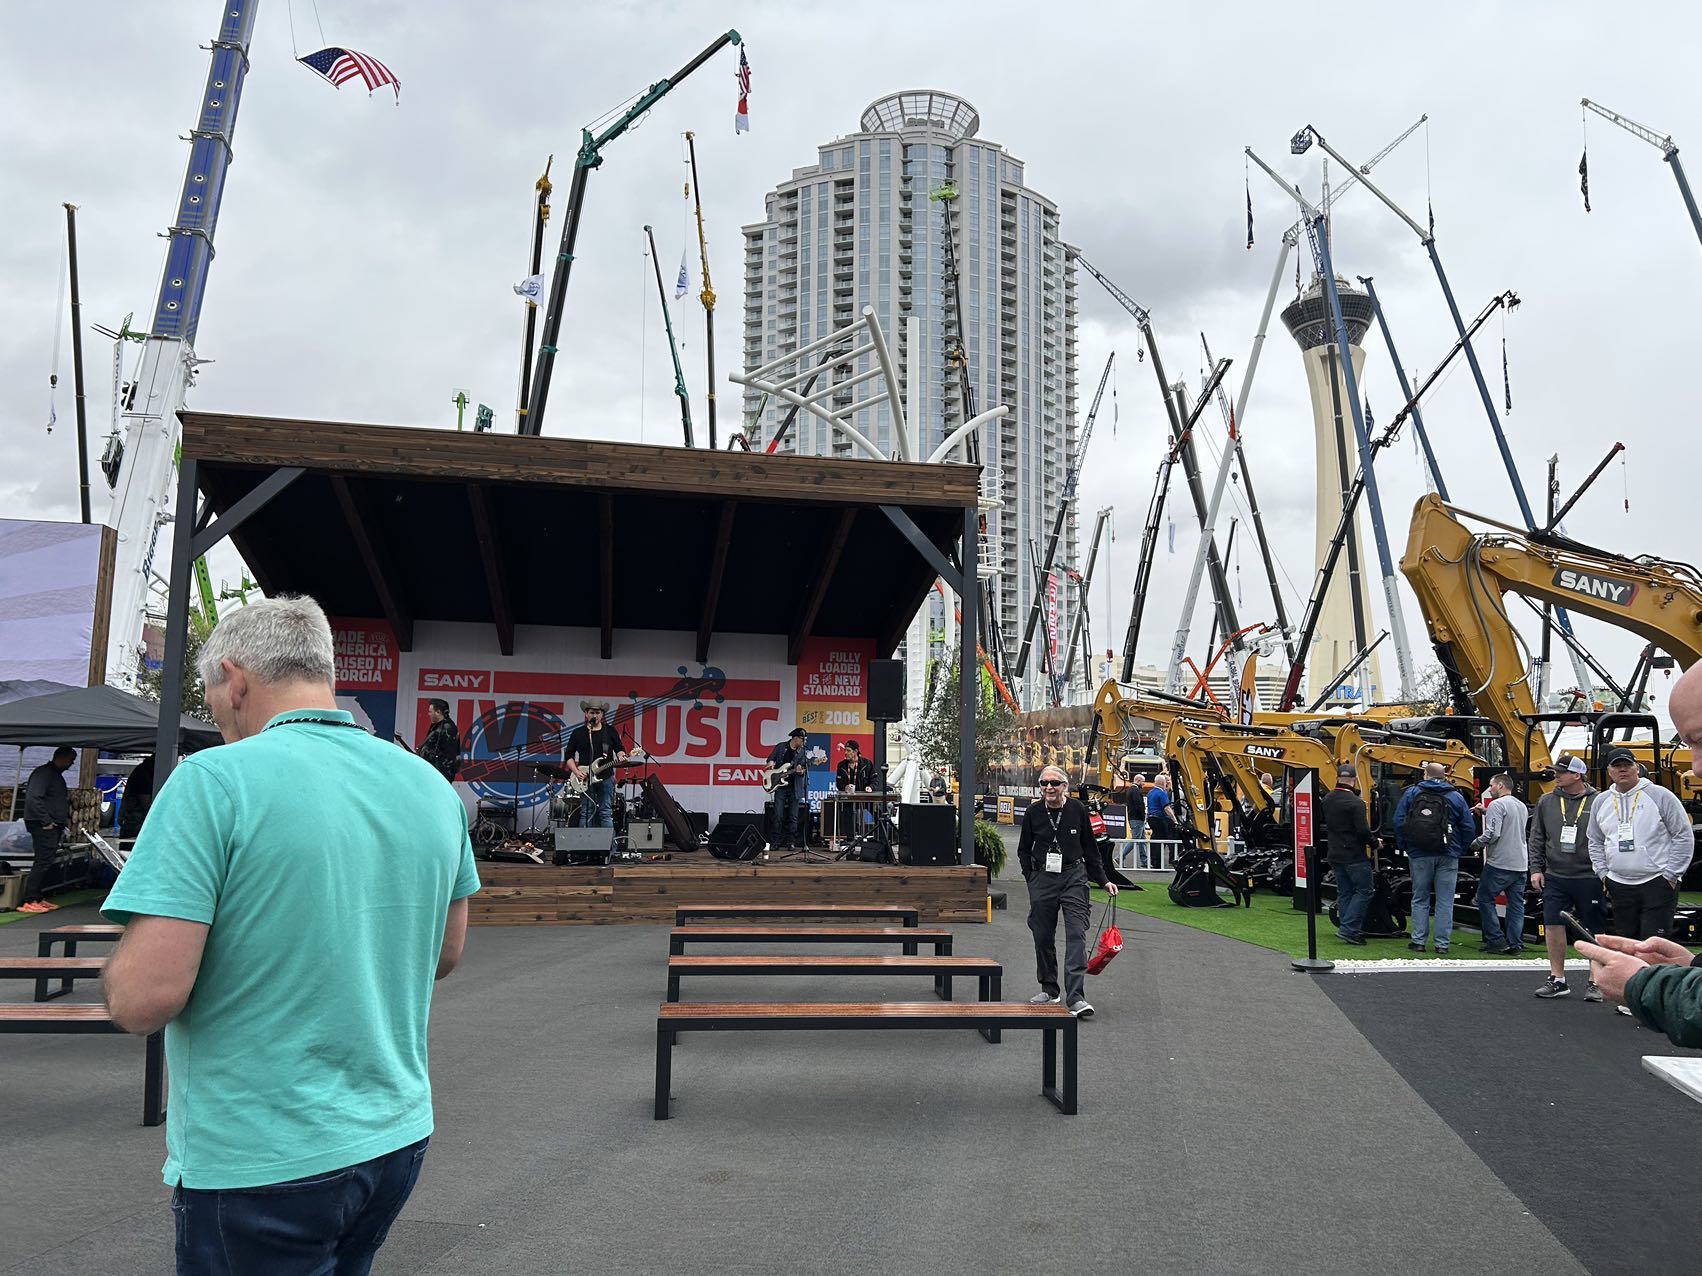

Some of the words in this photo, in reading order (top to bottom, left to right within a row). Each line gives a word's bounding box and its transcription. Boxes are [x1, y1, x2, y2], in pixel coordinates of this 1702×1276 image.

[1560, 570, 1624, 602] SANY
[335, 643, 387, 656] MERICA
[334, 656, 375, 669] AISED
[378, 658, 393, 671] IN
[829, 651, 861, 663] FULLY
[820, 663, 861, 674] LOADED
[335, 669, 383, 682] EORGIA
[424, 674, 484, 688] SANY
[809, 674, 820, 685] IS
[835, 675, 860, 685] NEW
[803, 684, 861, 696] STANDARD
[825, 711, 861, 725] 2006
[1247, 745, 1280, 758] SANY
